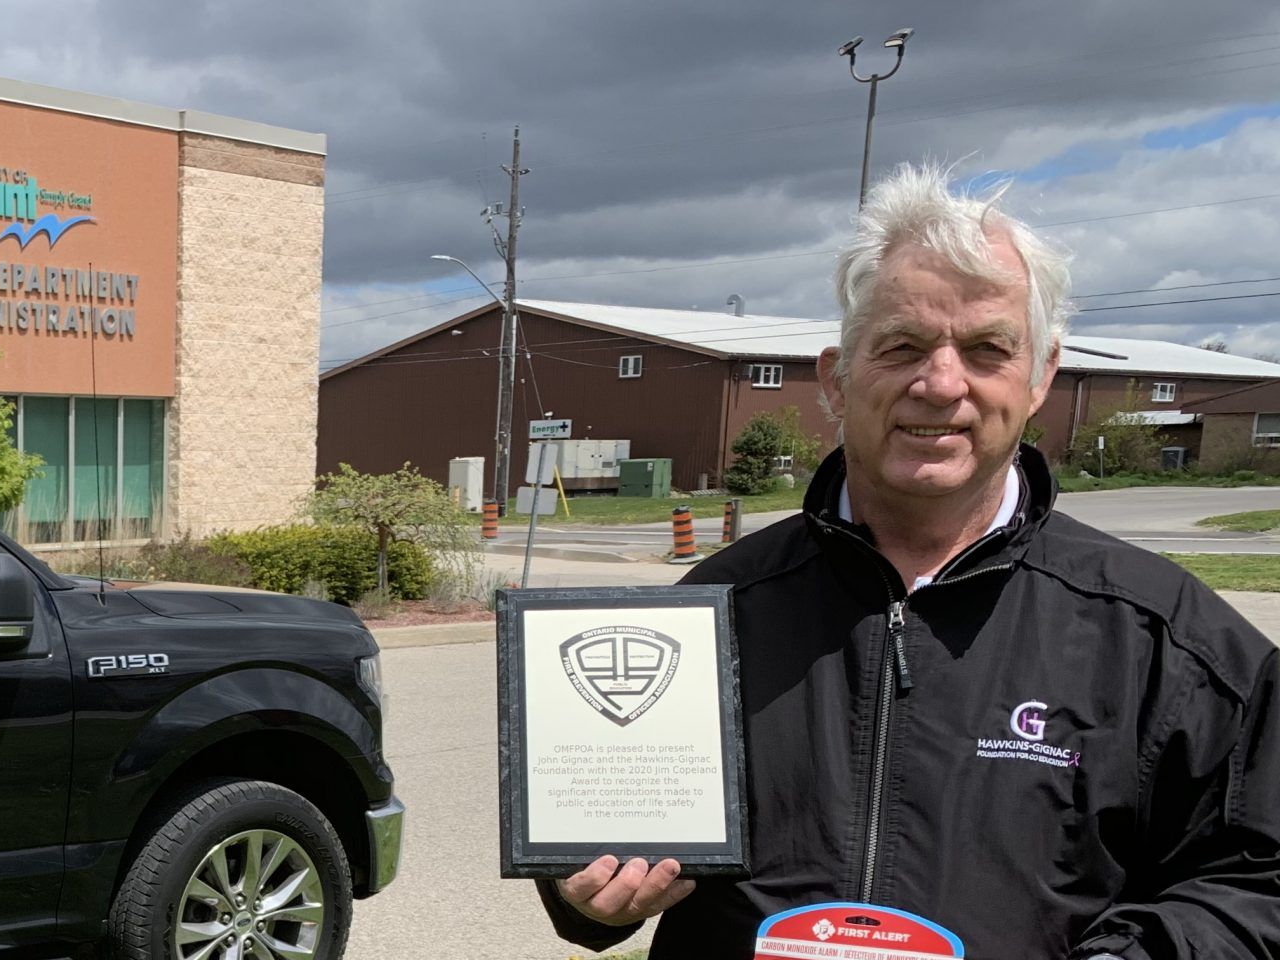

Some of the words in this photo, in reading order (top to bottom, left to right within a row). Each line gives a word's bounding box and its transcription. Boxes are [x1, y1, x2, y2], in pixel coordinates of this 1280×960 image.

[13, 169, 27, 184] OF
[582, 627, 614, 639] ONTARIO
[616, 627, 656, 638] MUNICIPAL
[896, 635, 908, 675] STORMTECH
[87, 653, 169, 677] F150
[562, 656, 574, 675] FIRE
[569, 674, 604, 711] PREVENTION
[628, 695, 657, 720] OFFICERS
[654, 652, 679, 698] ASSOCIATION
[554, 745, 593, 753] OMFPOA
[597, 744, 604, 753] is
[607, 744, 643, 755] pleased
[646, 745, 655, 753] to
[659, 745, 695, 755] present
[978, 738, 1071, 758] HAWKINS-GIGNAC
[538, 756, 558, 766] John
[561, 756, 593, 766] Gignac
[596, 755, 614, 764] and
[617, 755, 632, 764] the
[636, 754, 711, 766] Hawkins-Gignac
[977, 750, 1015, 759] FOUNDATION
[1038, 755, 1068, 767] EDUCATION
[533, 766, 584, 775] Foundation
[587, 766, 607, 775] with
[610, 766, 625, 775] the
[629, 766, 652, 774] 2020
[655, 766, 670, 776] Jim
[673, 765, 717, 776] Copeland
[571, 777, 599, 786] Award
[603, 778, 612, 786] to
[615, 777, 661, 788] recognize
[664, 777, 679, 786] the
[548, 788, 596, 799] significant
[599, 788, 661, 796] contributions
[664, 788, 691, 796] made
[694, 788, 703, 796] to
[556, 799, 584, 809] public
[588, 799, 634, 808] education
[638, 799, 646, 808] of
[649, 799, 663, 808] life
[666, 799, 696, 809] safety
[584, 809, 592, 818] in
[595, 809, 611, 818] the
[614, 809, 668, 820] community.
[837, 926, 870, 938] FIRST
[872, 930, 912, 943] ALERT
[761, 941, 785, 952] CARBON
[786, 944, 817, 955] MONOXIDE
[818, 947, 838, 957] ALARM
